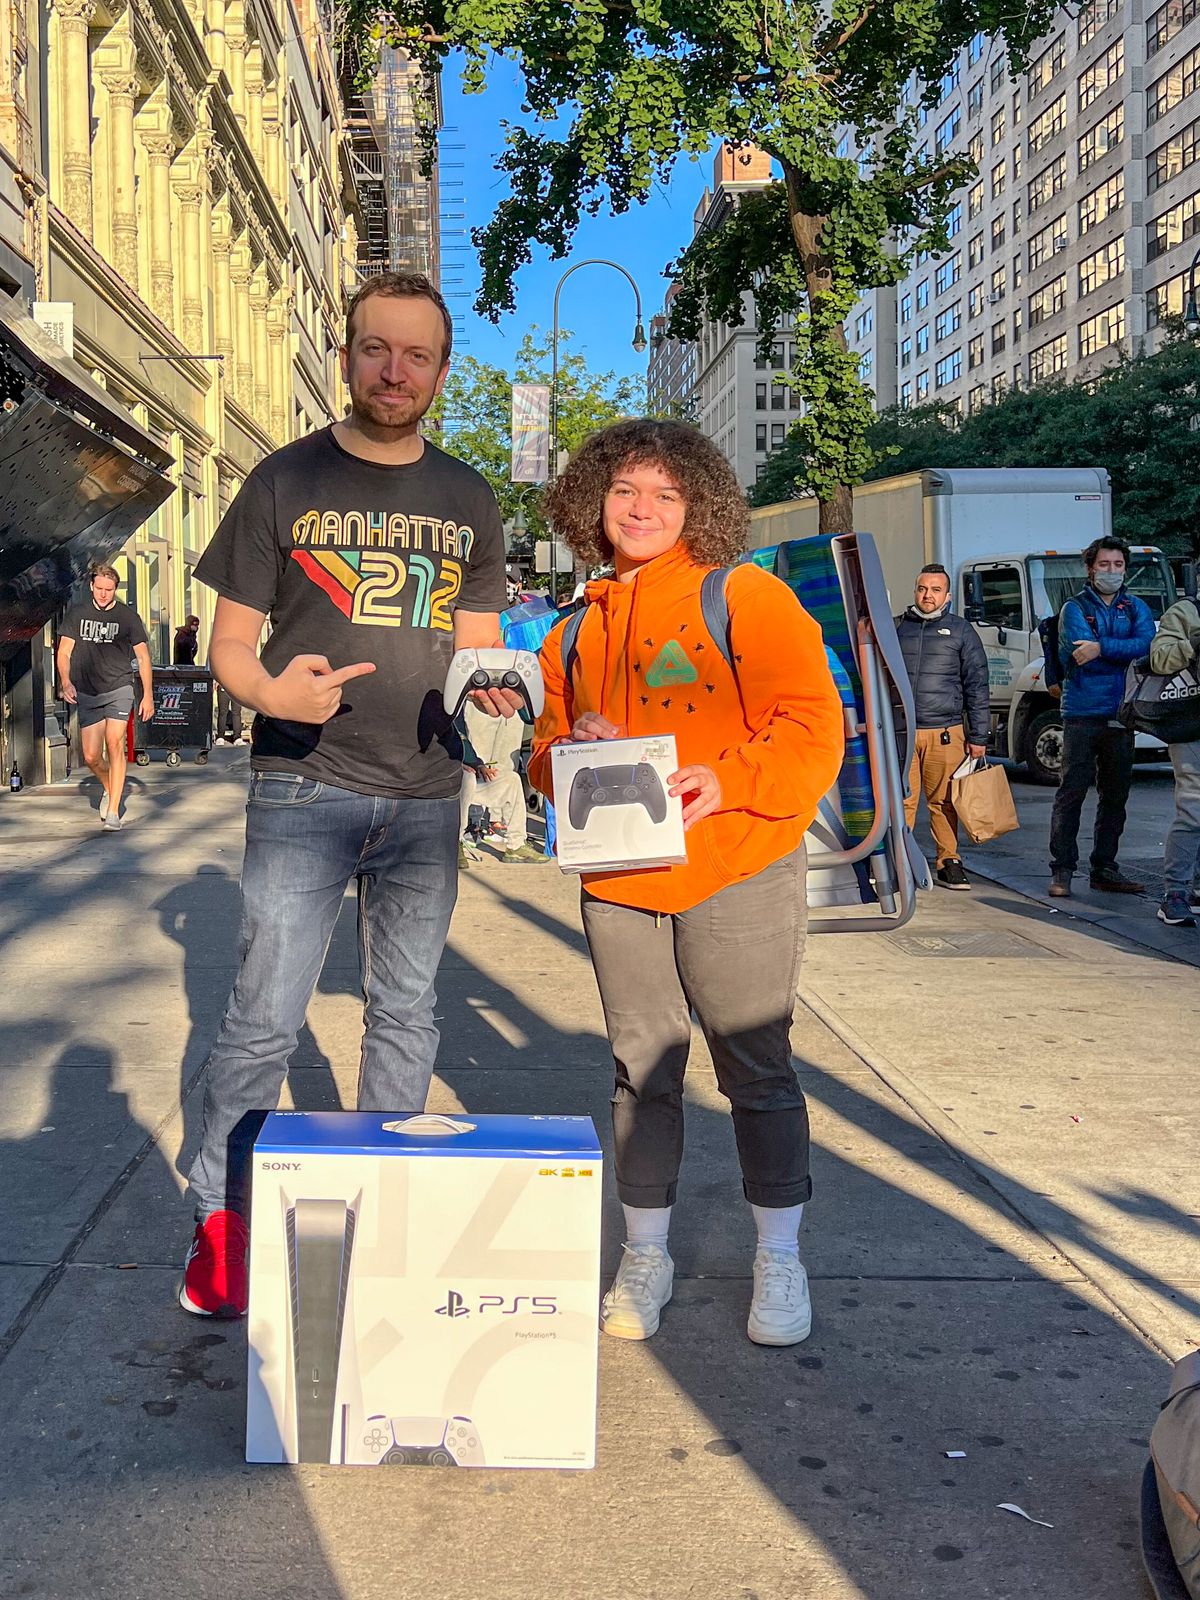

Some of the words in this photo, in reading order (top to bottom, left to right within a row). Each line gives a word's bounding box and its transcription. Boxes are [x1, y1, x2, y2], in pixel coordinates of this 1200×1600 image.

[291, 509, 475, 562] MANHATTAN
[352, 550, 463, 632] 212
[80, 619, 103, 639] LEVEL
[104, 622, 119, 640] UP
[261, 1162, 301, 1171] SONY
[479, 1295, 557, 1315] PS5
